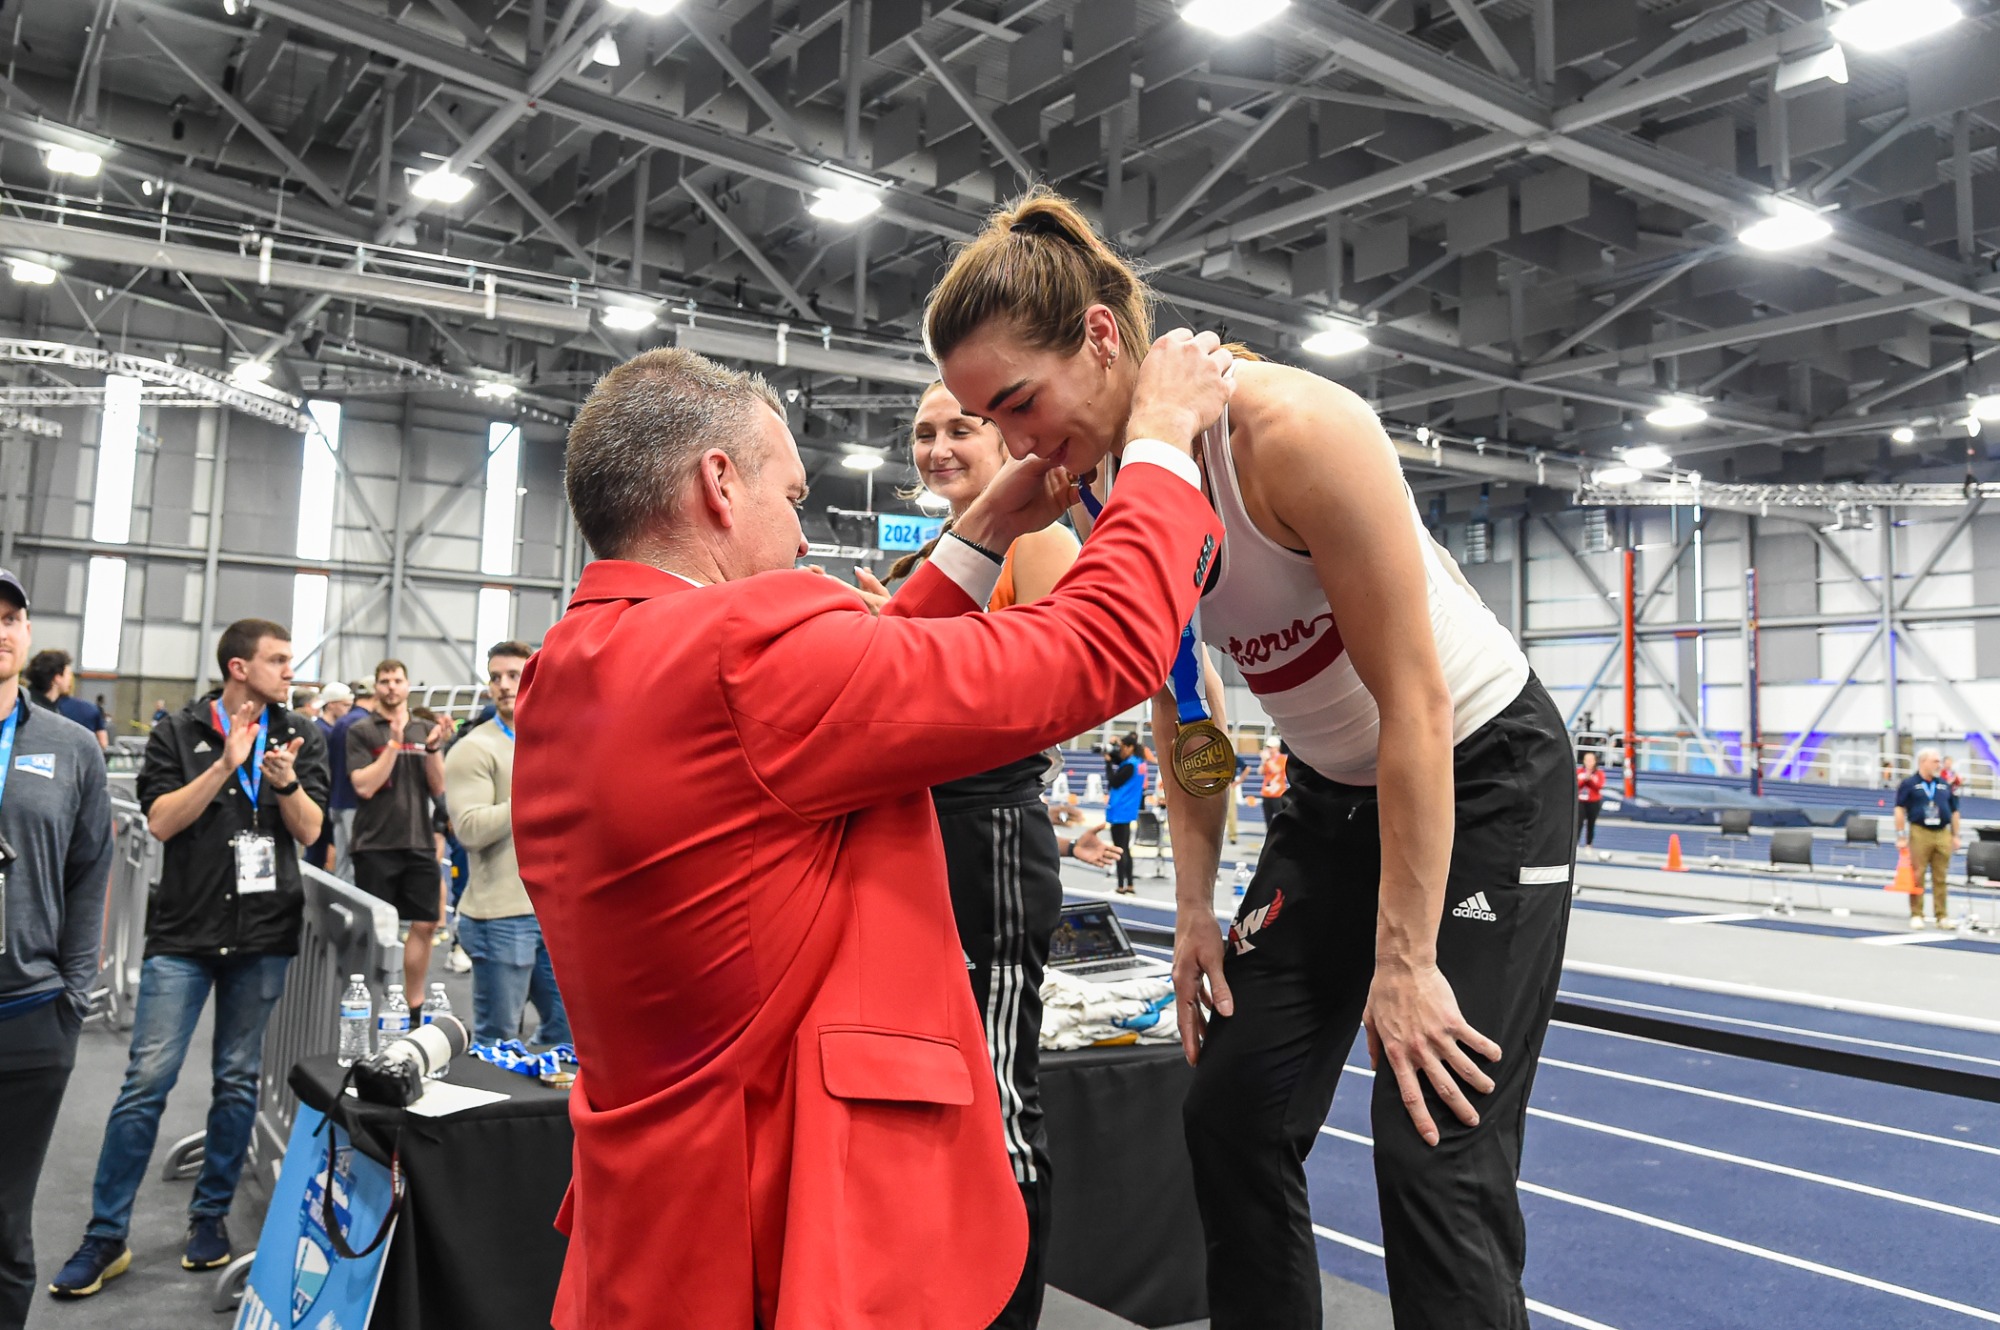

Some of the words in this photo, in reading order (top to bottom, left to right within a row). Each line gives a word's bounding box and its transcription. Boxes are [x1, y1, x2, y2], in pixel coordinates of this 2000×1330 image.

[884, 524, 921, 544] 2024
[1221, 619, 1318, 667] tern
[1452, 907, 1497, 922] adidas
